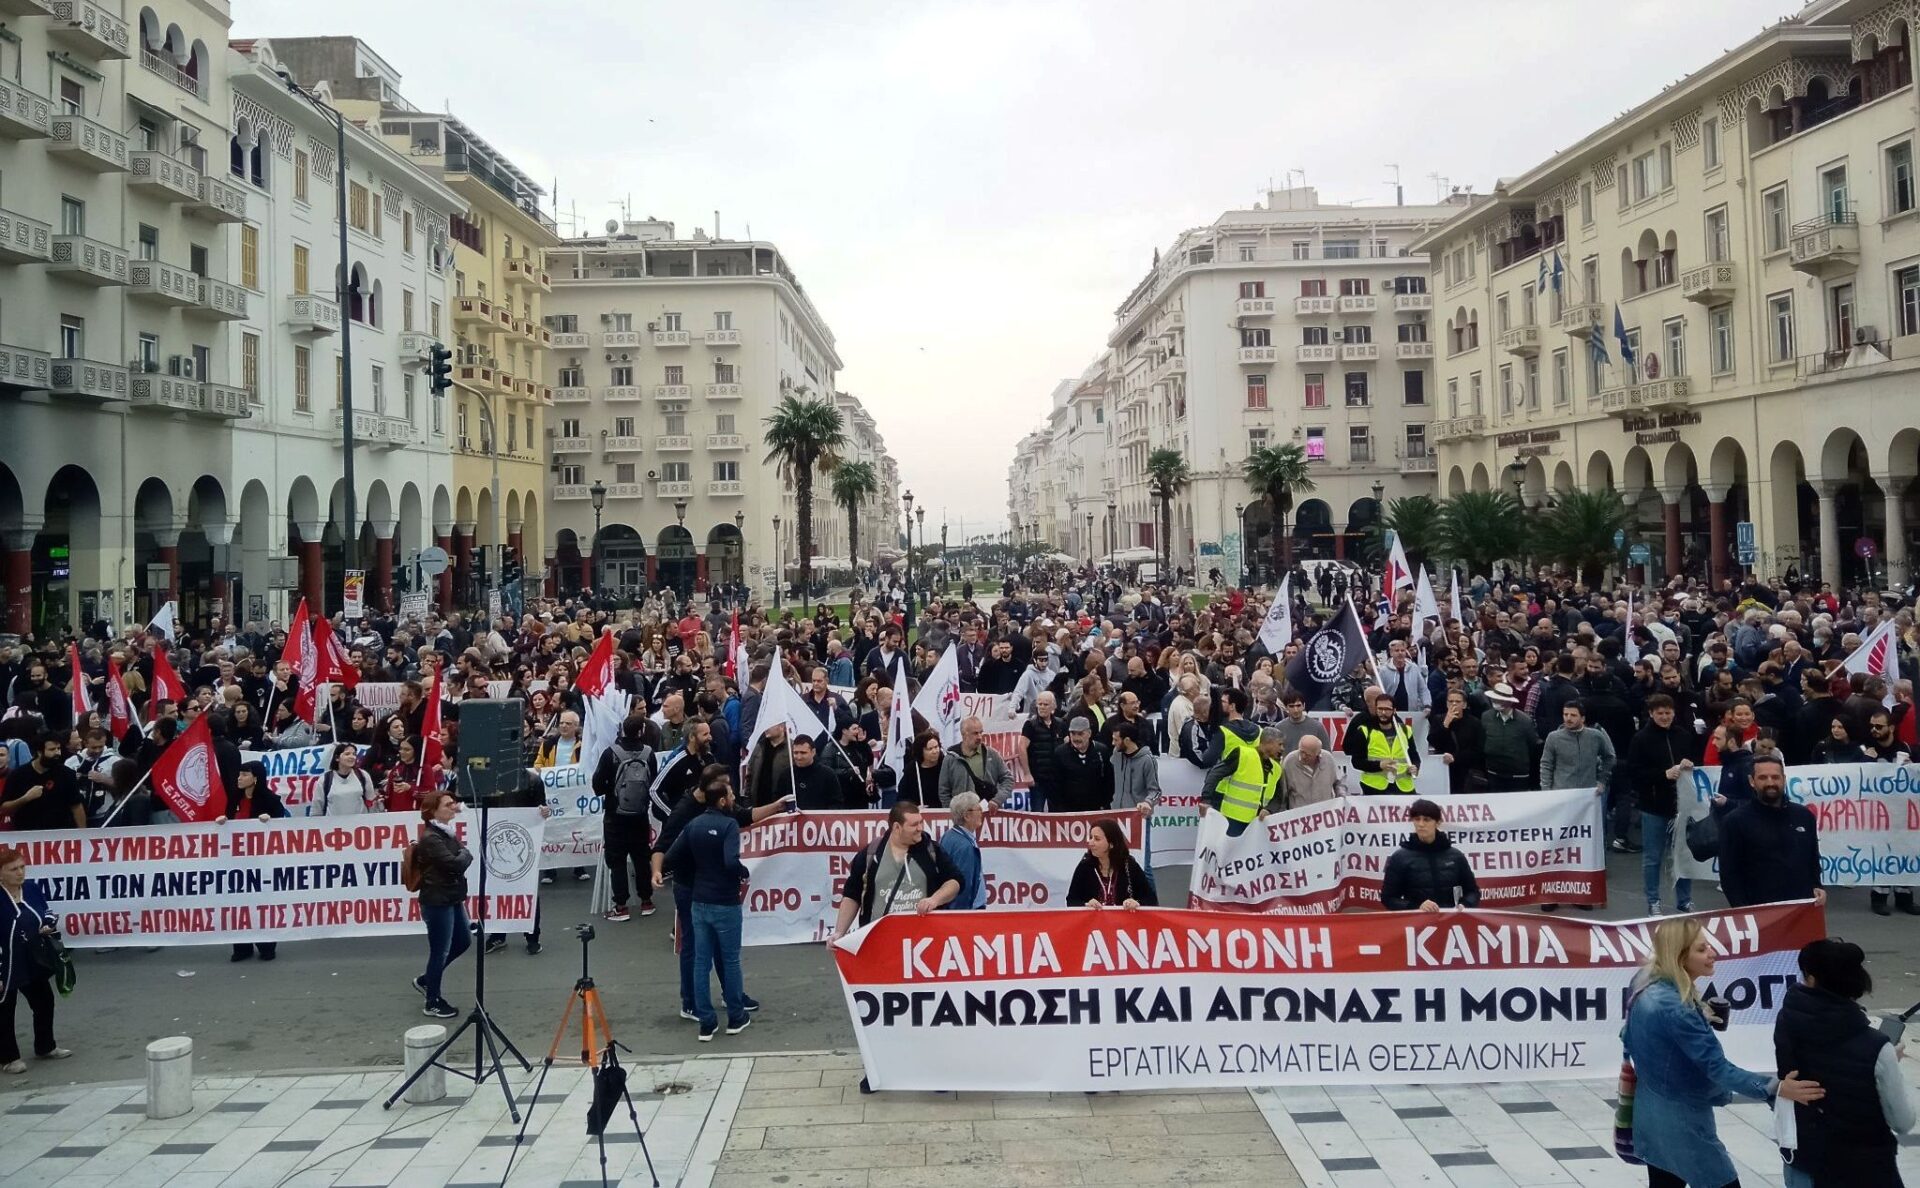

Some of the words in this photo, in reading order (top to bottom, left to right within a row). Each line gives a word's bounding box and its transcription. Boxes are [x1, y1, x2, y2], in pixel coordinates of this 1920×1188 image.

[963, 695, 993, 718] 9/11
[1807, 776, 1850, 797] των
[740, 821, 797, 853] ΡΓΗΣΗ
[803, 820, 859, 847] ΟΛΩΝ
[1268, 803, 1361, 843] ΣΥΓΧΡΟΝΑ
[1367, 804, 1495, 823] ΔΙΚΑΜΑΤΑ
[89, 824, 409, 864] ΣΥΜΒΑΣΗ-ΕΠΑΝΑΦΟΡΑ
[1270, 838, 1336, 865] ΧΡΟΝΟΣ
[1449, 827, 1553, 844] ΕΡΙΣΣΟΤΕΡΗ
[1560, 824, 1592, 841] ΖΩΗ
[1467, 847, 1582, 870] ΤΕΠΙΘΕΣΗ
[96, 873, 145, 900] ΤΩΝ
[151, 863, 358, 898] ΑΝΕΡΓΩΝ-ΜΕΤΡΑ
[1541, 881, 1592, 896] ΜΑΚΕΔΟΝΙΑΣ
[65, 906, 216, 937] ΘΥΣΙΕΣ-ΑΓΩΝΑΣ
[221, 904, 251, 931] ΓΙΑ
[254, 903, 288, 929] ΤΙΣ
[292, 898, 402, 928] ΣΥΓΧΡΟΝΕΣ
[903, 931, 1062, 979] ΚΑΜΙΑ
[1082, 927, 1333, 972] ΑΝΑΜΟΝΗ
[1405, 924, 1569, 967] ΚΑΜΙΑ
[1590, 913, 1760, 964] ΑΝΧΗ
[852, 987, 1101, 1027] ΟΡΓΑΝΩΣΗ
[1115, 986, 1193, 1024] ΚΑΙ
[1205, 985, 1403, 1024] ΑΓΩΝΑΣ
[1414, 987, 1446, 1023] Η
[1459, 985, 1607, 1023] ΜΟΝΗ
[1089, 1045, 1211, 1079] ΕΡΓΑΤΙΚΑ
[1219, 1043, 1361, 1075] ΣΩΜΑΤΕΙΑ
[1368, 1041, 1587, 1074] ΘΕΣΣΑΛΟΝΙΚΗΣ
